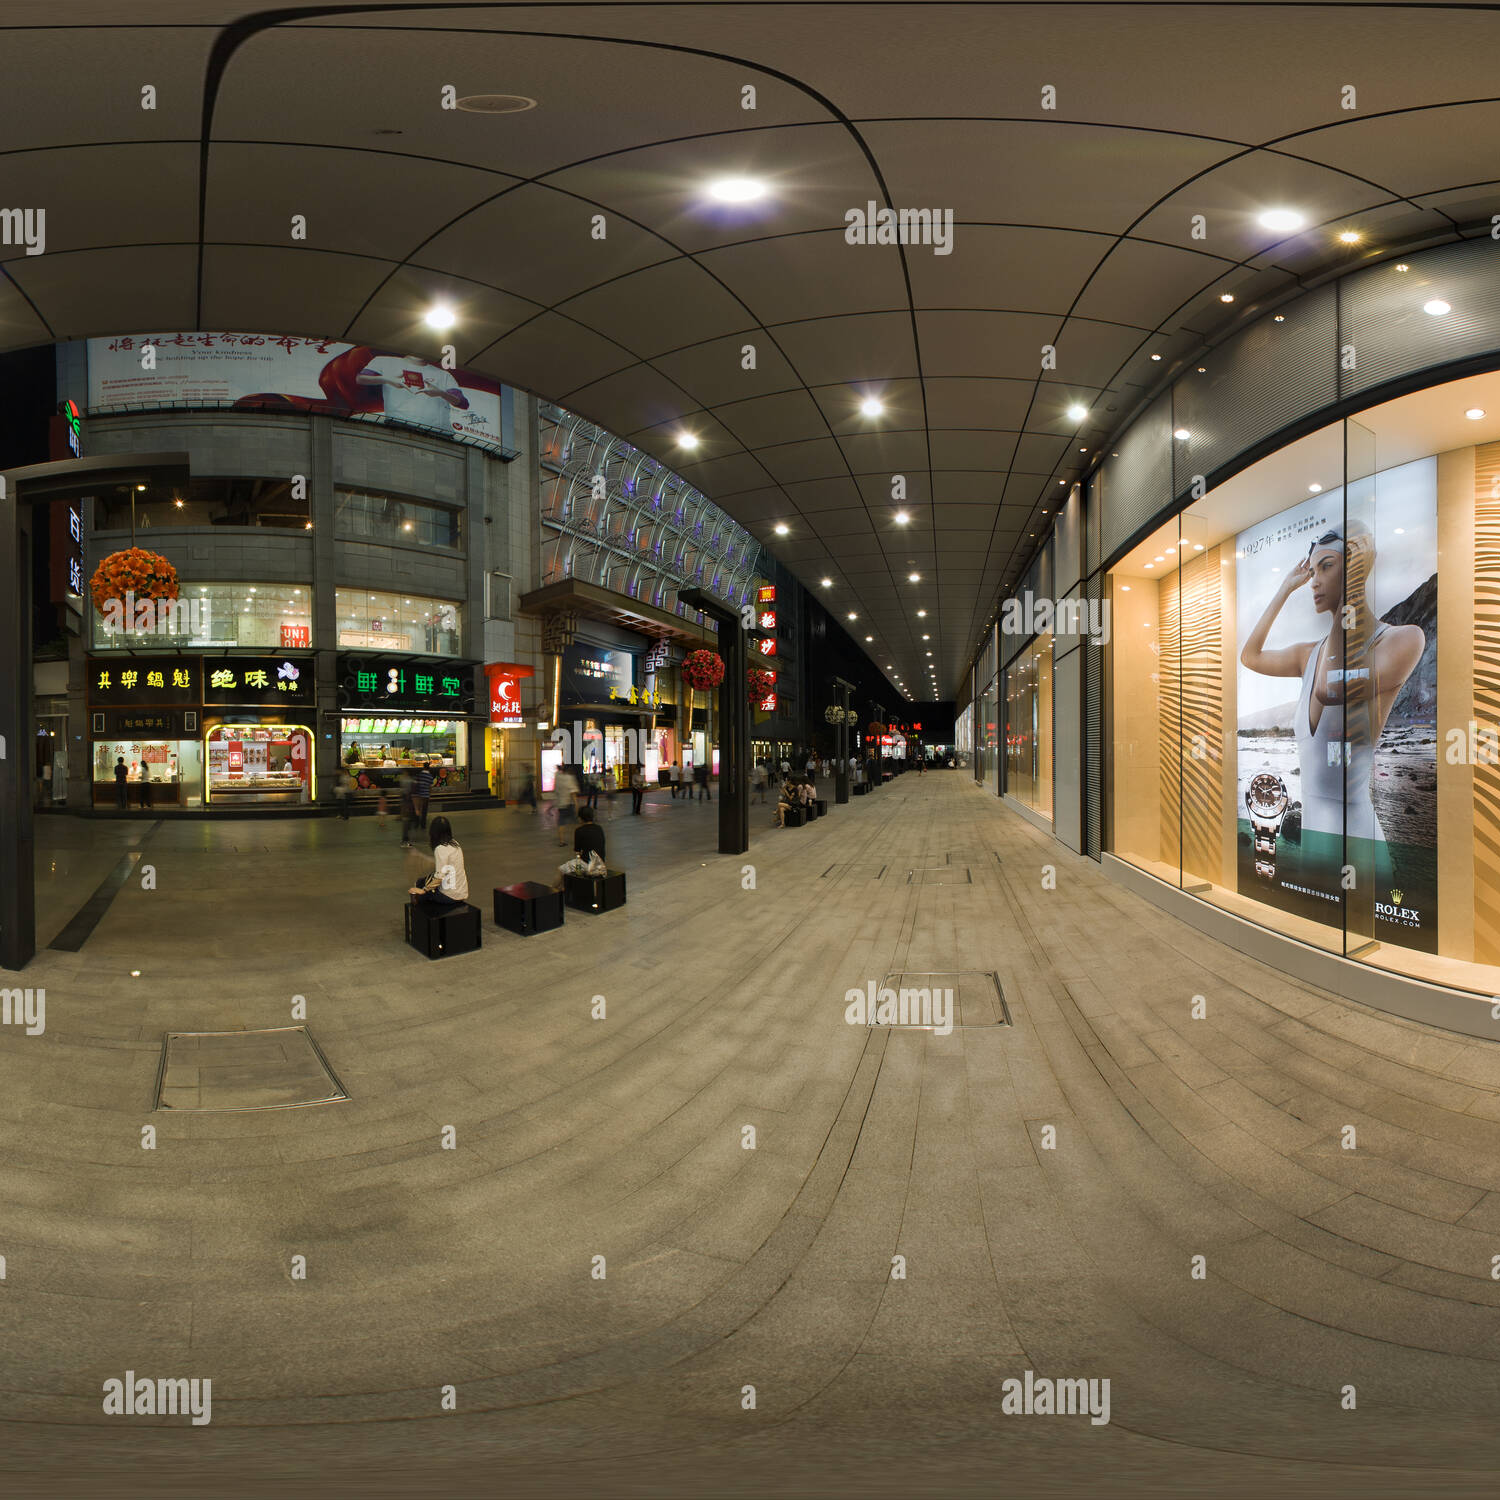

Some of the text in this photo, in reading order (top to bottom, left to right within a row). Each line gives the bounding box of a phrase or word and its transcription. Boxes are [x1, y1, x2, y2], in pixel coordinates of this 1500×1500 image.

[284, 629, 304, 639] UNI
[210, 669, 270, 689] 绝味
[1375, 902, 1420, 921] ROLEX
[1375, 914, 1420, 928] ROLEX.COM
